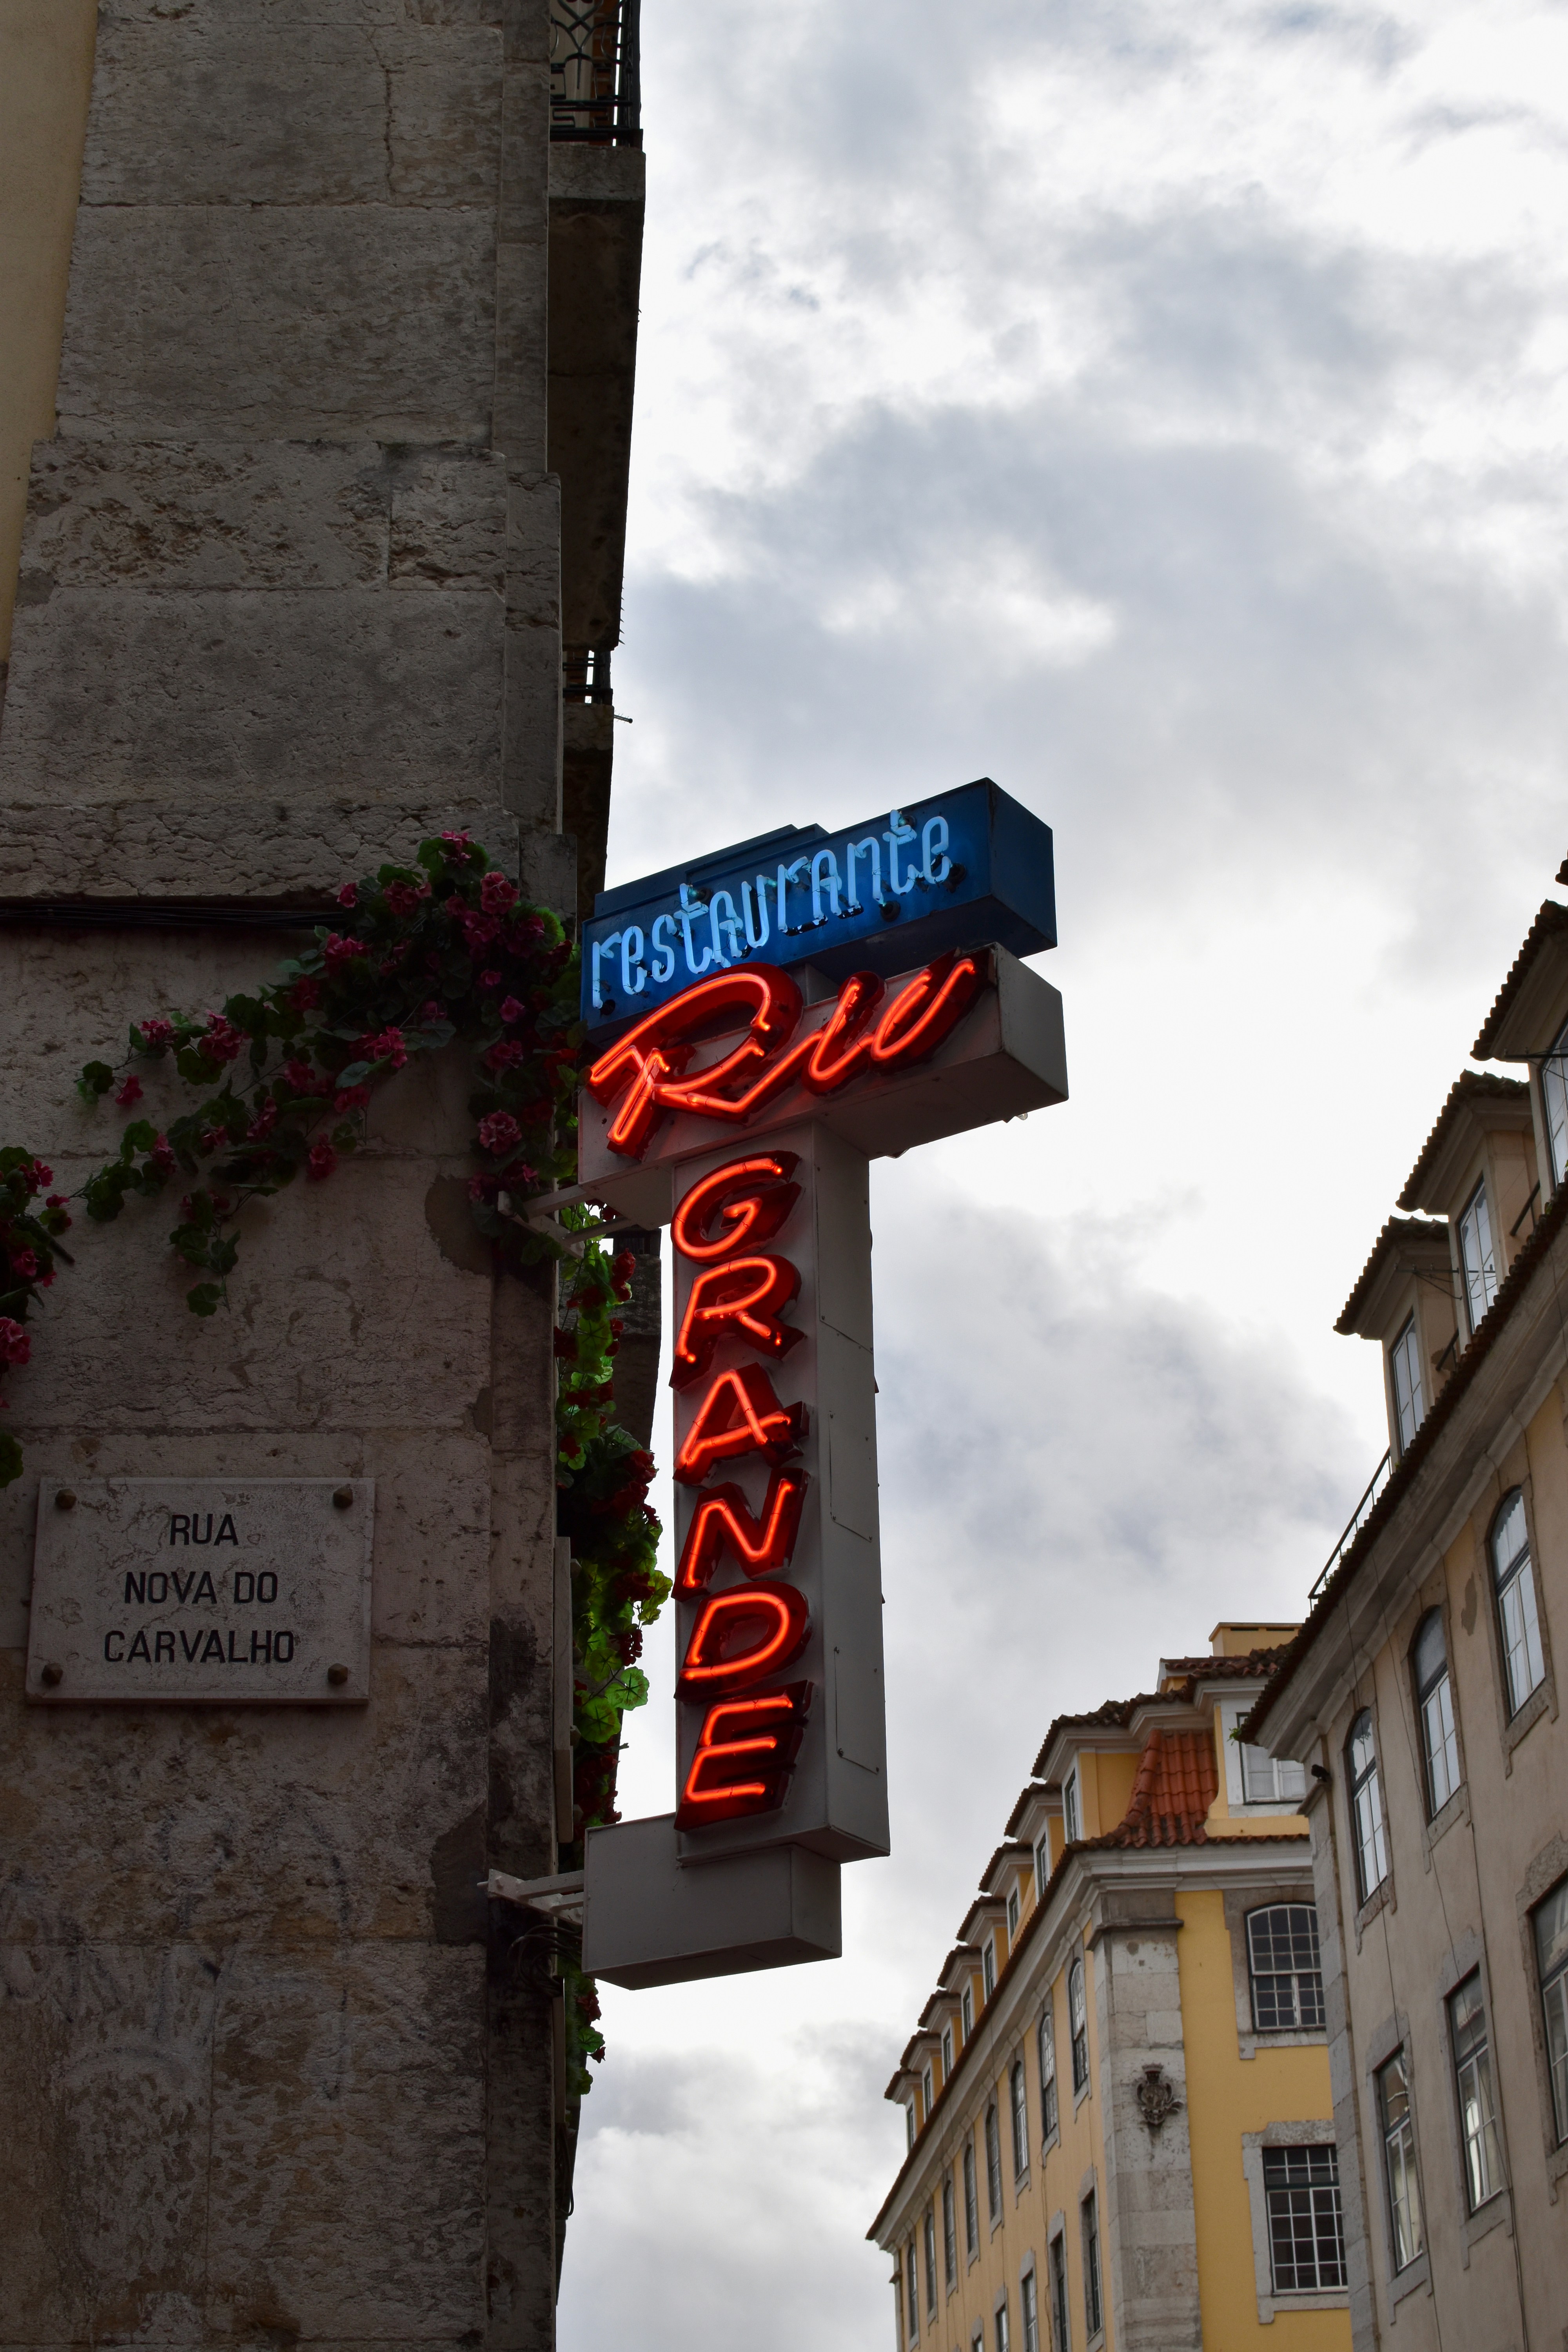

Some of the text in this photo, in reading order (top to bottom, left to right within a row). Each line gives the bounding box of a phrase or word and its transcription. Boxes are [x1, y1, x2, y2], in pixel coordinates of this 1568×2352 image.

[587, 953, 982, 1154] Rio
[672, 1151, 808, 1833] GRANDE
[170, 1513, 239, 1546] RUA
[124, 1571, 278, 1604] NOVA DO
[104, 1630, 294, 1663] CARVALHO
